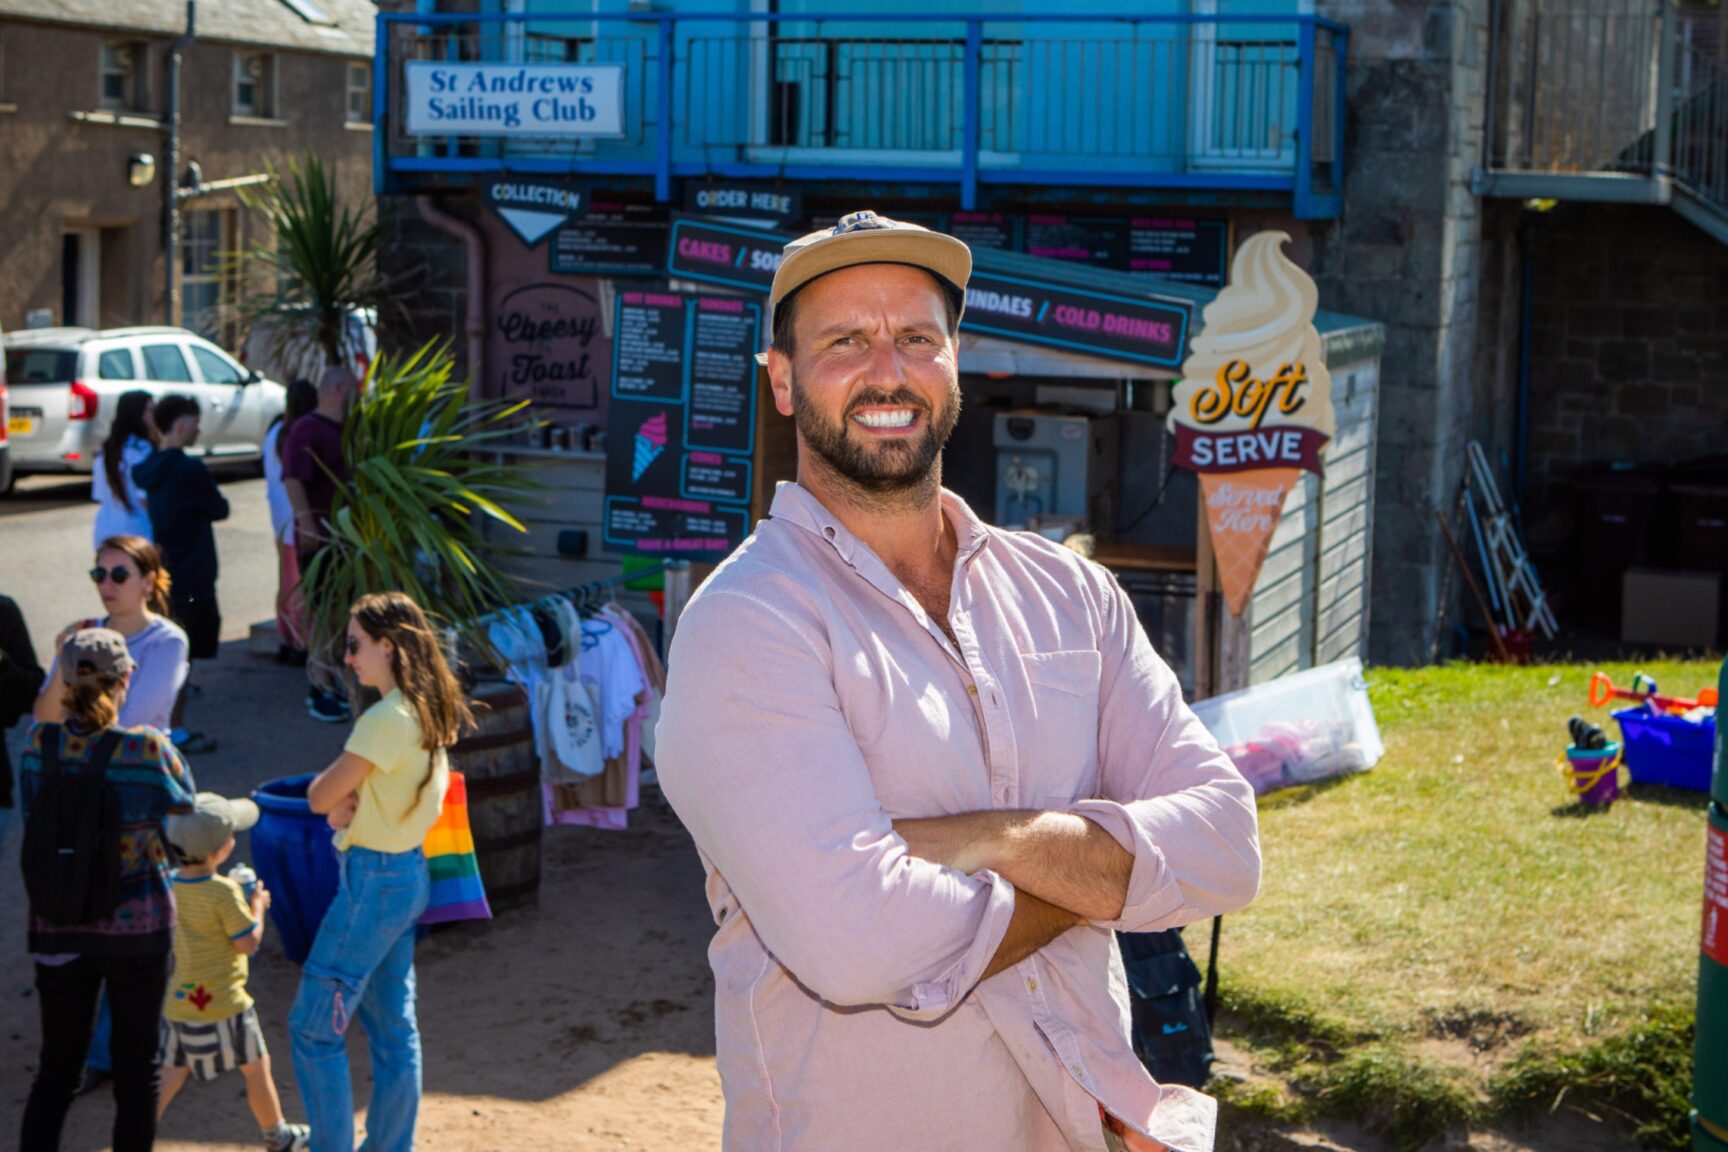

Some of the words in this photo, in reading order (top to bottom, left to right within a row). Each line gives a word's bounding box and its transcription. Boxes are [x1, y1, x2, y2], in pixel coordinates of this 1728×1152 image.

[430, 69, 457, 92] St
[468, 69, 594, 93] Andrews
[428, 97, 521, 127] Sailing
[532, 97, 596, 122] Club
[492, 184, 580, 210] COLLECTION
[697, 190, 748, 208] ORDER
[751, 192, 791, 214] HERE
[678, 237, 731, 267] CAKES
[498, 310, 597, 347] Cheesy
[966, 287, 1033, 318] UNDAES
[1054, 304, 1099, 329] COLD
[1103, 313, 1172, 343] DRINKS
[512, 353, 591, 384] Toast
[1189, 359, 1308, 430] Soft
[1190, 431, 1303, 466] SERVE
[1209, 482, 1285, 511] Served
[1215, 507, 1273, 533] Here
